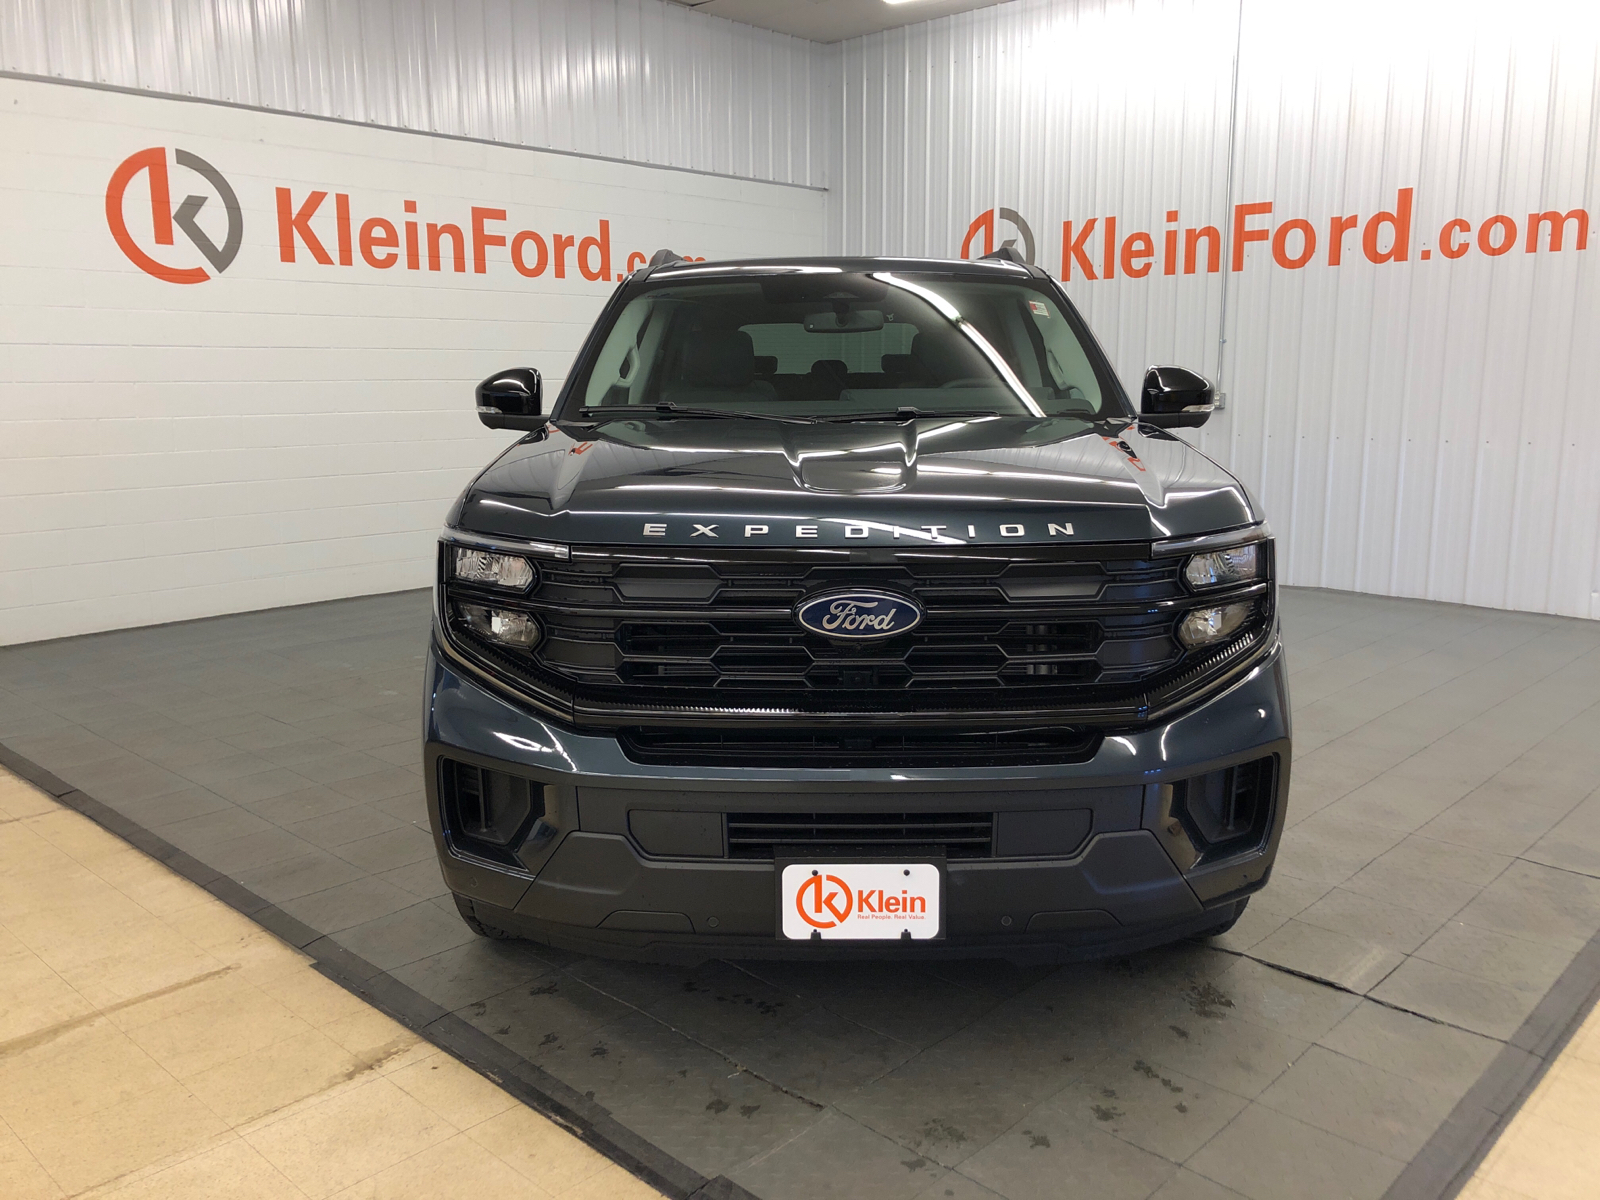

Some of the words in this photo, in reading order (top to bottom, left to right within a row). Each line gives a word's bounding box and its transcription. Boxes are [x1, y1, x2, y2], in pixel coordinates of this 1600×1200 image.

[275, 186, 706, 283] KleinFord.c
[1060, 187, 1590, 283] KleinFord.com
[642, 522, 1075, 539] EXPEDITION
[821, 600, 897, 632] Ford
[857, 889, 926, 914] Klein
[871, 913, 892, 921] People.
